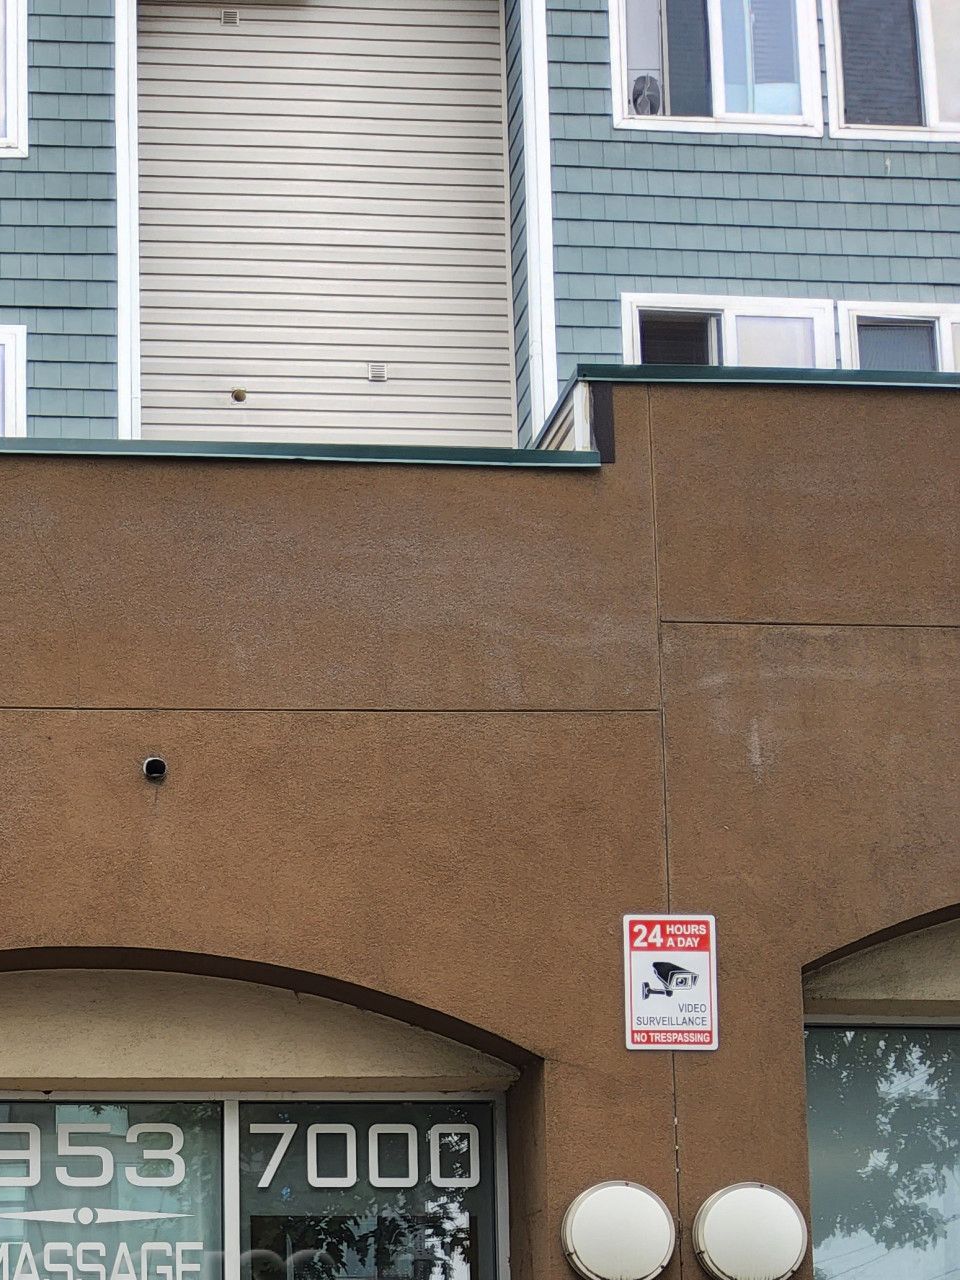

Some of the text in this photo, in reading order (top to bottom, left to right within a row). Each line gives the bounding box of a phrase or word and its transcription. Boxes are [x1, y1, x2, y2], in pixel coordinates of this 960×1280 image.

[633, 924, 707, 947] 24 HOURS
[667, 937, 700, 947] A DAY
[678, 1003, 707, 1013] VIDEO
[636, 1016, 707, 1026] SURVEILLANCE
[634, 1033, 710, 1043] NO TRESPASSING
[249, 1123, 480, 1188] 7000
